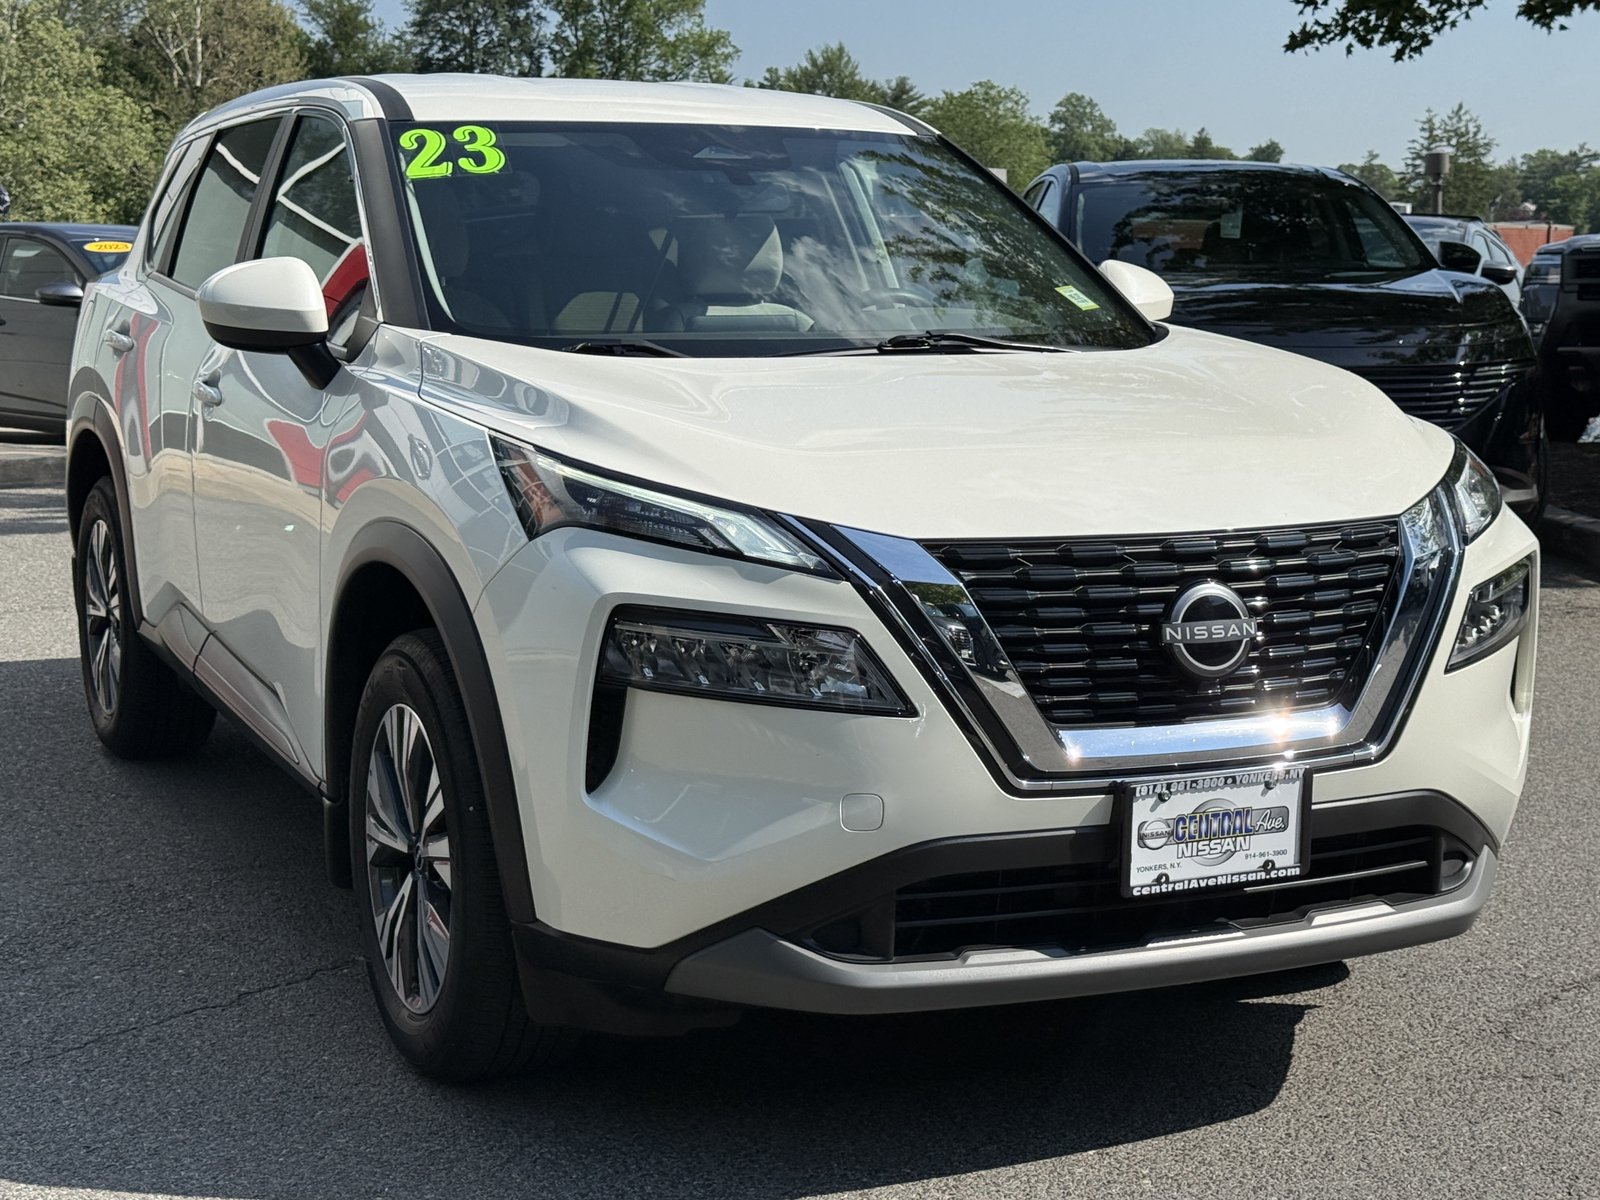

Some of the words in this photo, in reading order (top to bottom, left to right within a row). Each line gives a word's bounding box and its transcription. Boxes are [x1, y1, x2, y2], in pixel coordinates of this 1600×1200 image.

[399, 125, 506, 179] 23
[1165, 621, 1256, 641] NISSAN
[1142, 830, 1171, 839] NISSAN
[1173, 807, 1253, 843] CENTRAL
[1255, 809, 1285, 832] Ave.
[1177, 836, 1252, 859] NISSAN
[1244, 849, 1288, 860] 914-961-3900
[1136, 863, 1169, 873] YONKERS,
[1169, 861, 1182, 870] N.Y.
